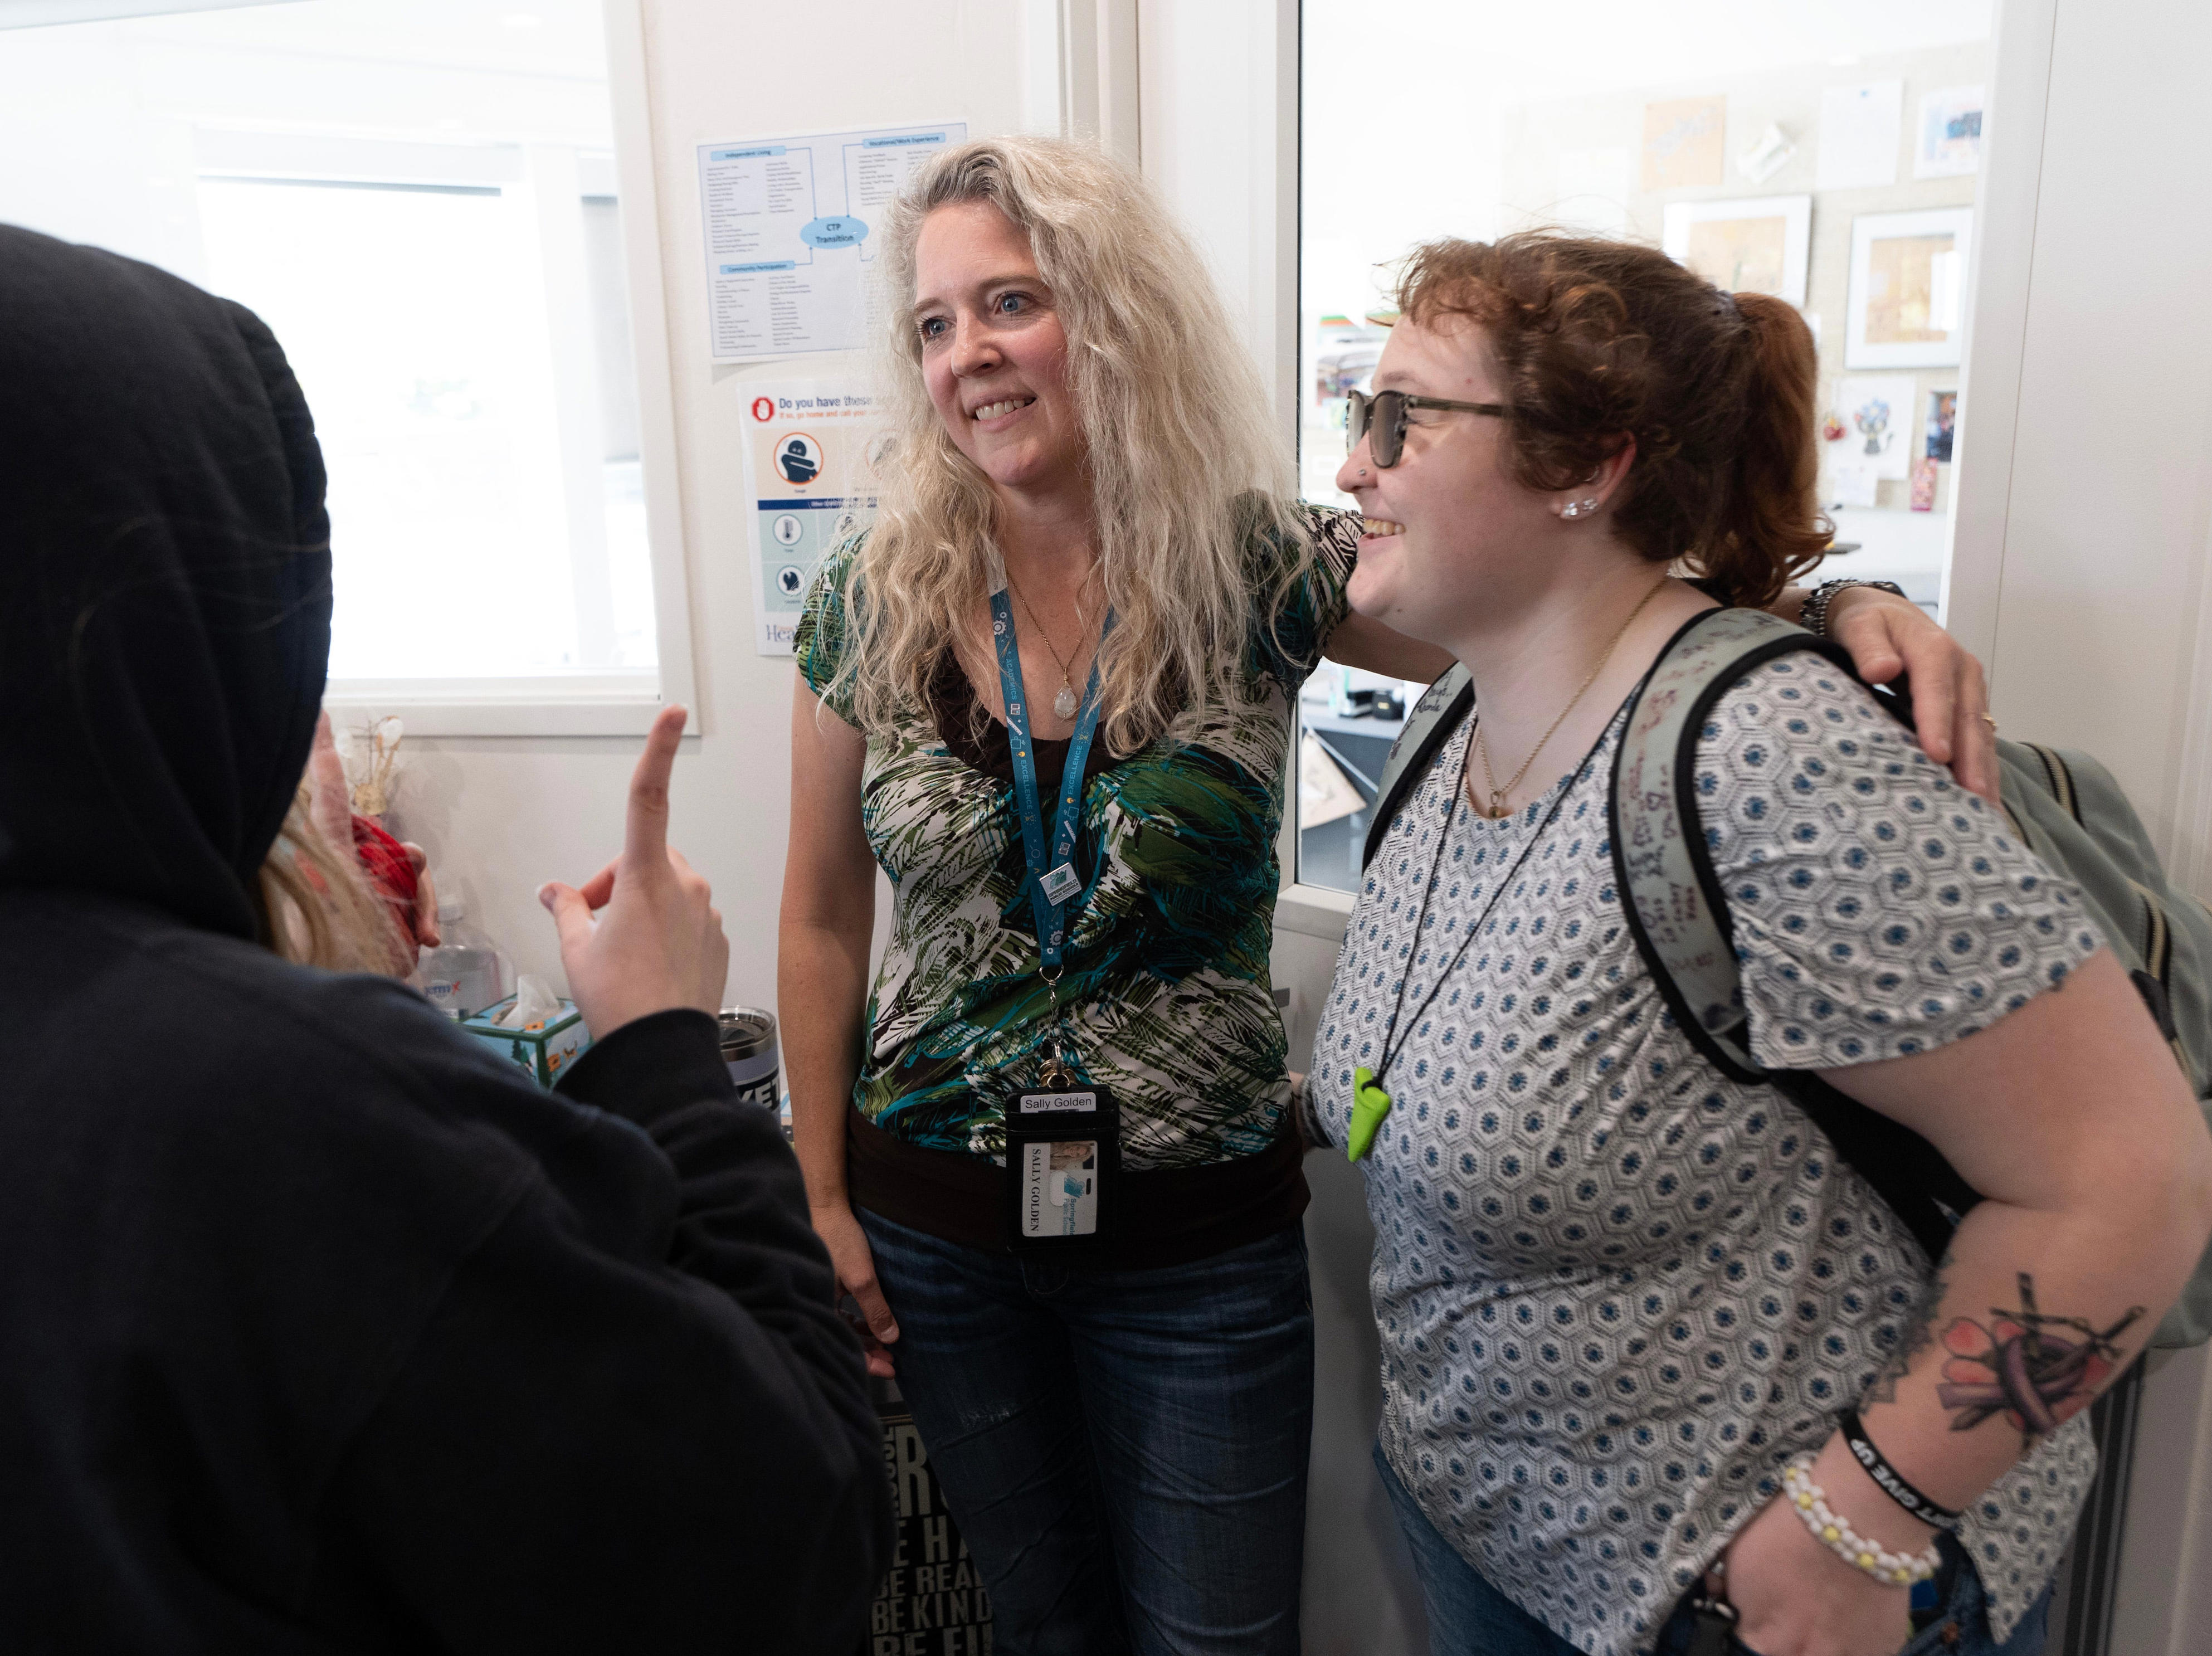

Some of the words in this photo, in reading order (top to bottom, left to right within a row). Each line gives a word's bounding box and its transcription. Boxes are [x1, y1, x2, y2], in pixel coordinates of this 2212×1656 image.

[815, 234, 854, 244] Transition
[826, 223, 841, 231] CTP
[779, 397, 792, 409] Do
[795, 399, 813, 410] you
[816, 396, 841, 407] have
[766, 624, 798, 642] Hea
[1005, 658, 1017, 700] ACADEMICS
[1020, 759, 1034, 811] EXCELLENCE
[1068, 744, 1083, 796] EXCELLENCE
[1025, 1099, 1051, 1110] Sally
[1054, 1097, 1092, 1108] Golden
[1031, 1148, 1041, 1184] SALLY
[1030, 1187, 1040, 1231] GOLDEN
[871, 1597, 905, 1635] BE
[913, 1588, 993, 1629] KIND
